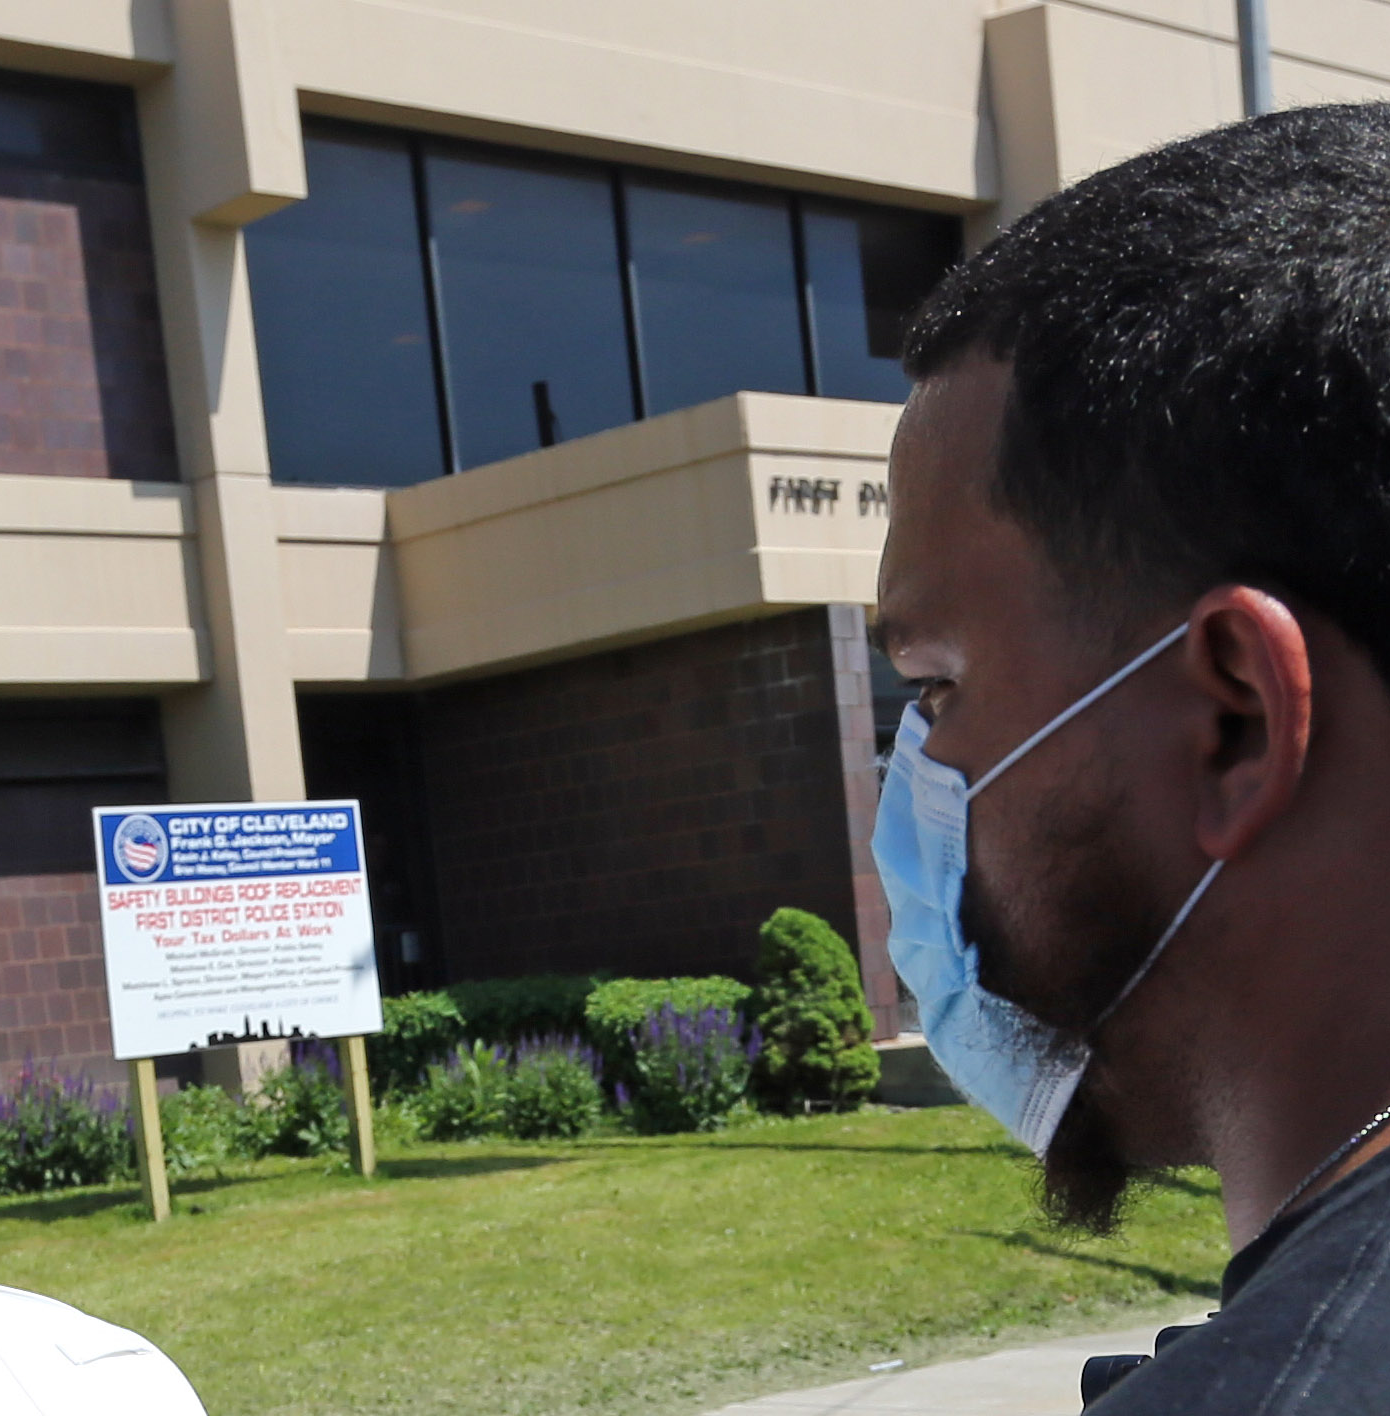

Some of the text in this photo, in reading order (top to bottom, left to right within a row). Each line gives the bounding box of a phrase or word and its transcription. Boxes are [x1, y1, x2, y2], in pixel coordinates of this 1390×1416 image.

[770, 477, 841, 513] FIRST
[168, 813, 349, 835] CITY OF CLEVELAND
[170, 835, 212, 850] Frank
[231, 833, 292, 848] Jackson,
[291, 832, 336, 846] Mayor
[108, 878, 361, 911] SAFETY BUILDINGS ROOF REPLACEMENT
[136, 901, 344, 930] FIRST DISTRICT POLICE STATION
[154, 924, 332, 947] Your Tax Dollars At Work
